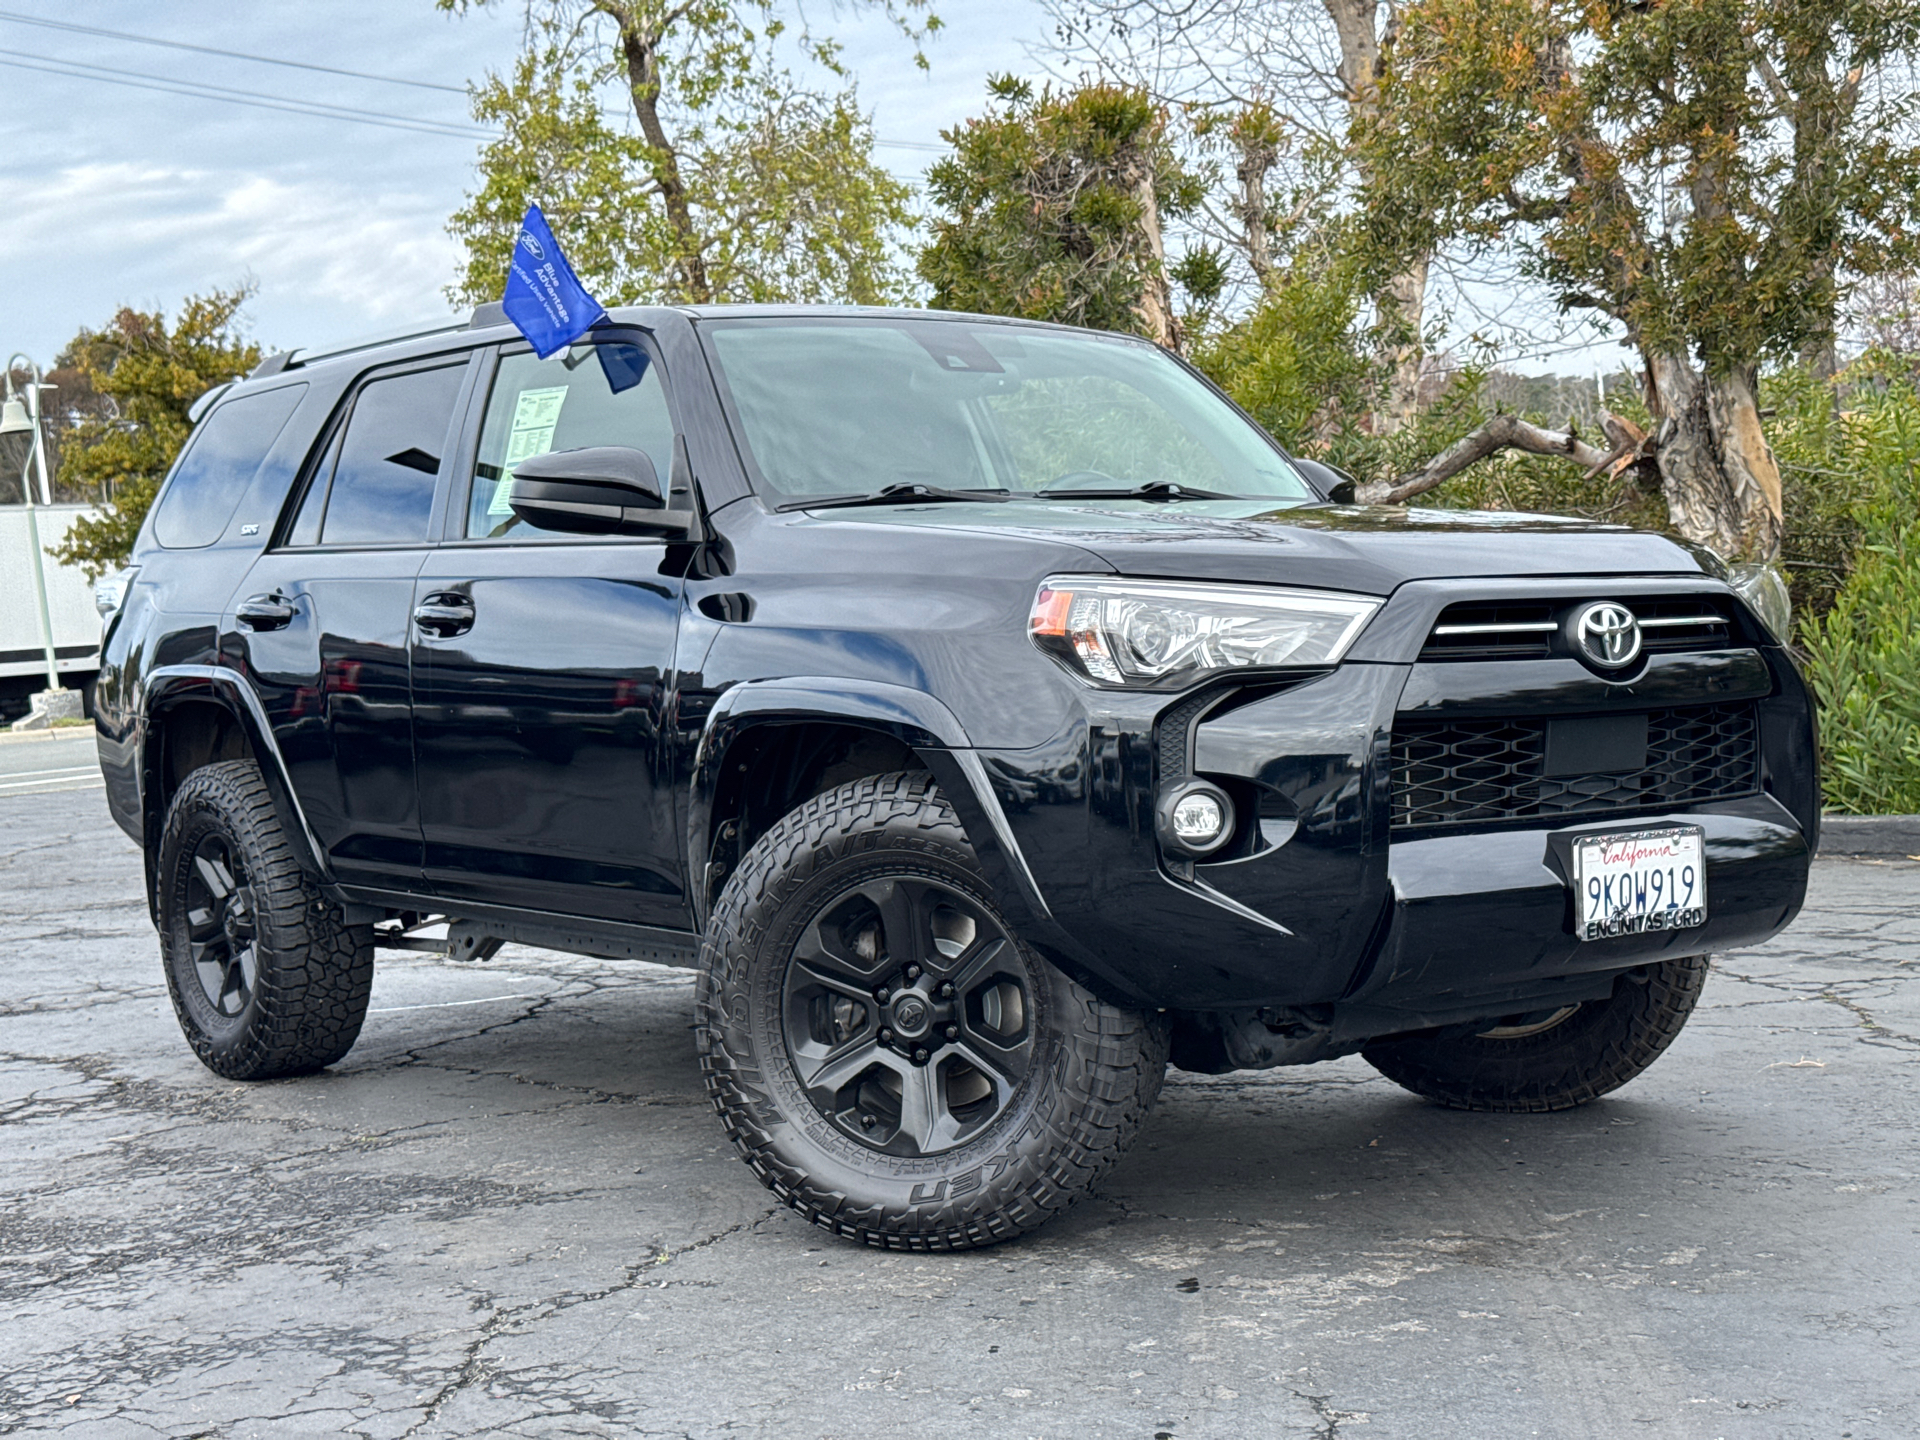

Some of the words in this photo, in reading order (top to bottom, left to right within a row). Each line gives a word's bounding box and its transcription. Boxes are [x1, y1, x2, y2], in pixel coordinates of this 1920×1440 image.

[520, 231, 541, 256] Ford
[542, 262, 560, 288] Blue
[529, 282, 546, 303] Used
[543, 301, 561, 329] Vehicle
[534, 268, 570, 323] Advantage
[1603, 840, 1679, 869] California
[1586, 911, 1664, 940] ENCINITAS
[1665, 908, 1701, 930] FORD
